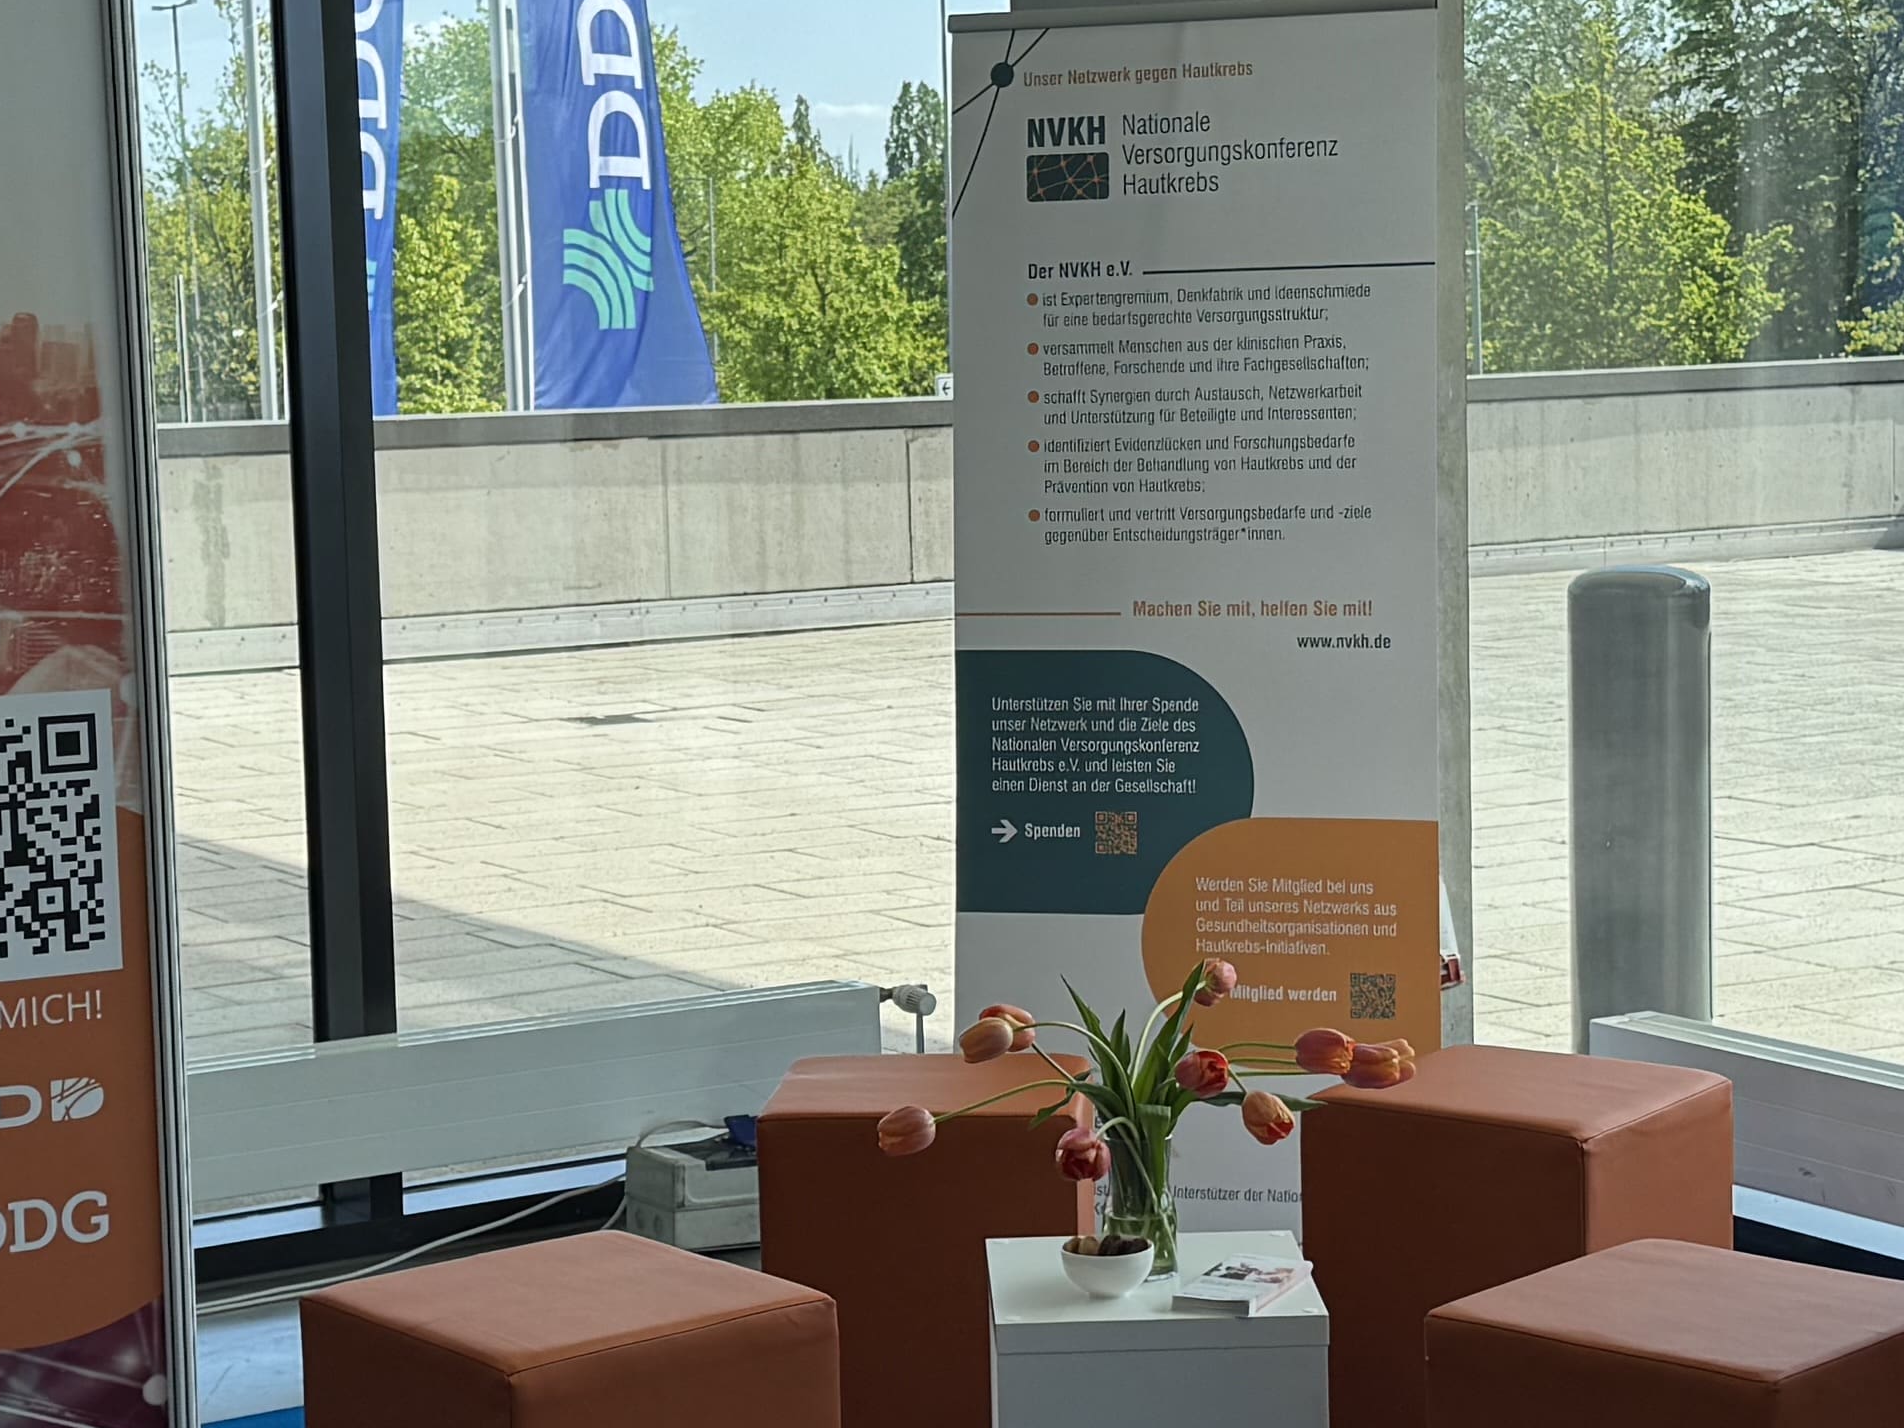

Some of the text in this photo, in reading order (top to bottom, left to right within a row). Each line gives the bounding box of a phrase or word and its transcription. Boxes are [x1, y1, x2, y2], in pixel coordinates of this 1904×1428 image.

[1023, 61, 1253, 87] Unser Netzwerk gegen Hautkrebs
[1027, 115, 1106, 148] NVKH
[1122, 112, 1210, 135] Nationale
[1122, 137, 1338, 168] Versorgungskonferenz
[1123, 172, 1219, 196] Hautkrebs
[1028, 261, 1131, 280] Der NVKH e.V.
[1042, 283, 1371, 309] ist Expertengremium, Denkfabrik und Ideenschmiede
[1133, 599, 1372, 619] Machen Sie mit, helfen Sie mit!
[1297, 634, 1391, 650] www.nvkh.de
[992, 697, 1199, 713] Unterstützen Sie mit Ihrer Spende
[992, 717, 1195, 733] unser Netzwerk und die Ziele des
[992, 737, 1199, 755] Nationalen Versorgungskonferenz
[992, 758, 1175, 773] Hautkrebs e.V. und leisten Sie
[992, 778, 1196, 793] einen Dienst an der Gesellschaft!
[1025, 822, 1080, 839] Spenden
[1196, 918, 1396, 937] Gesundheitsorganisationen und
[1229, 986, 1336, 1002] Mitglied werden
[1267, 1188, 1302, 1203] Natio
